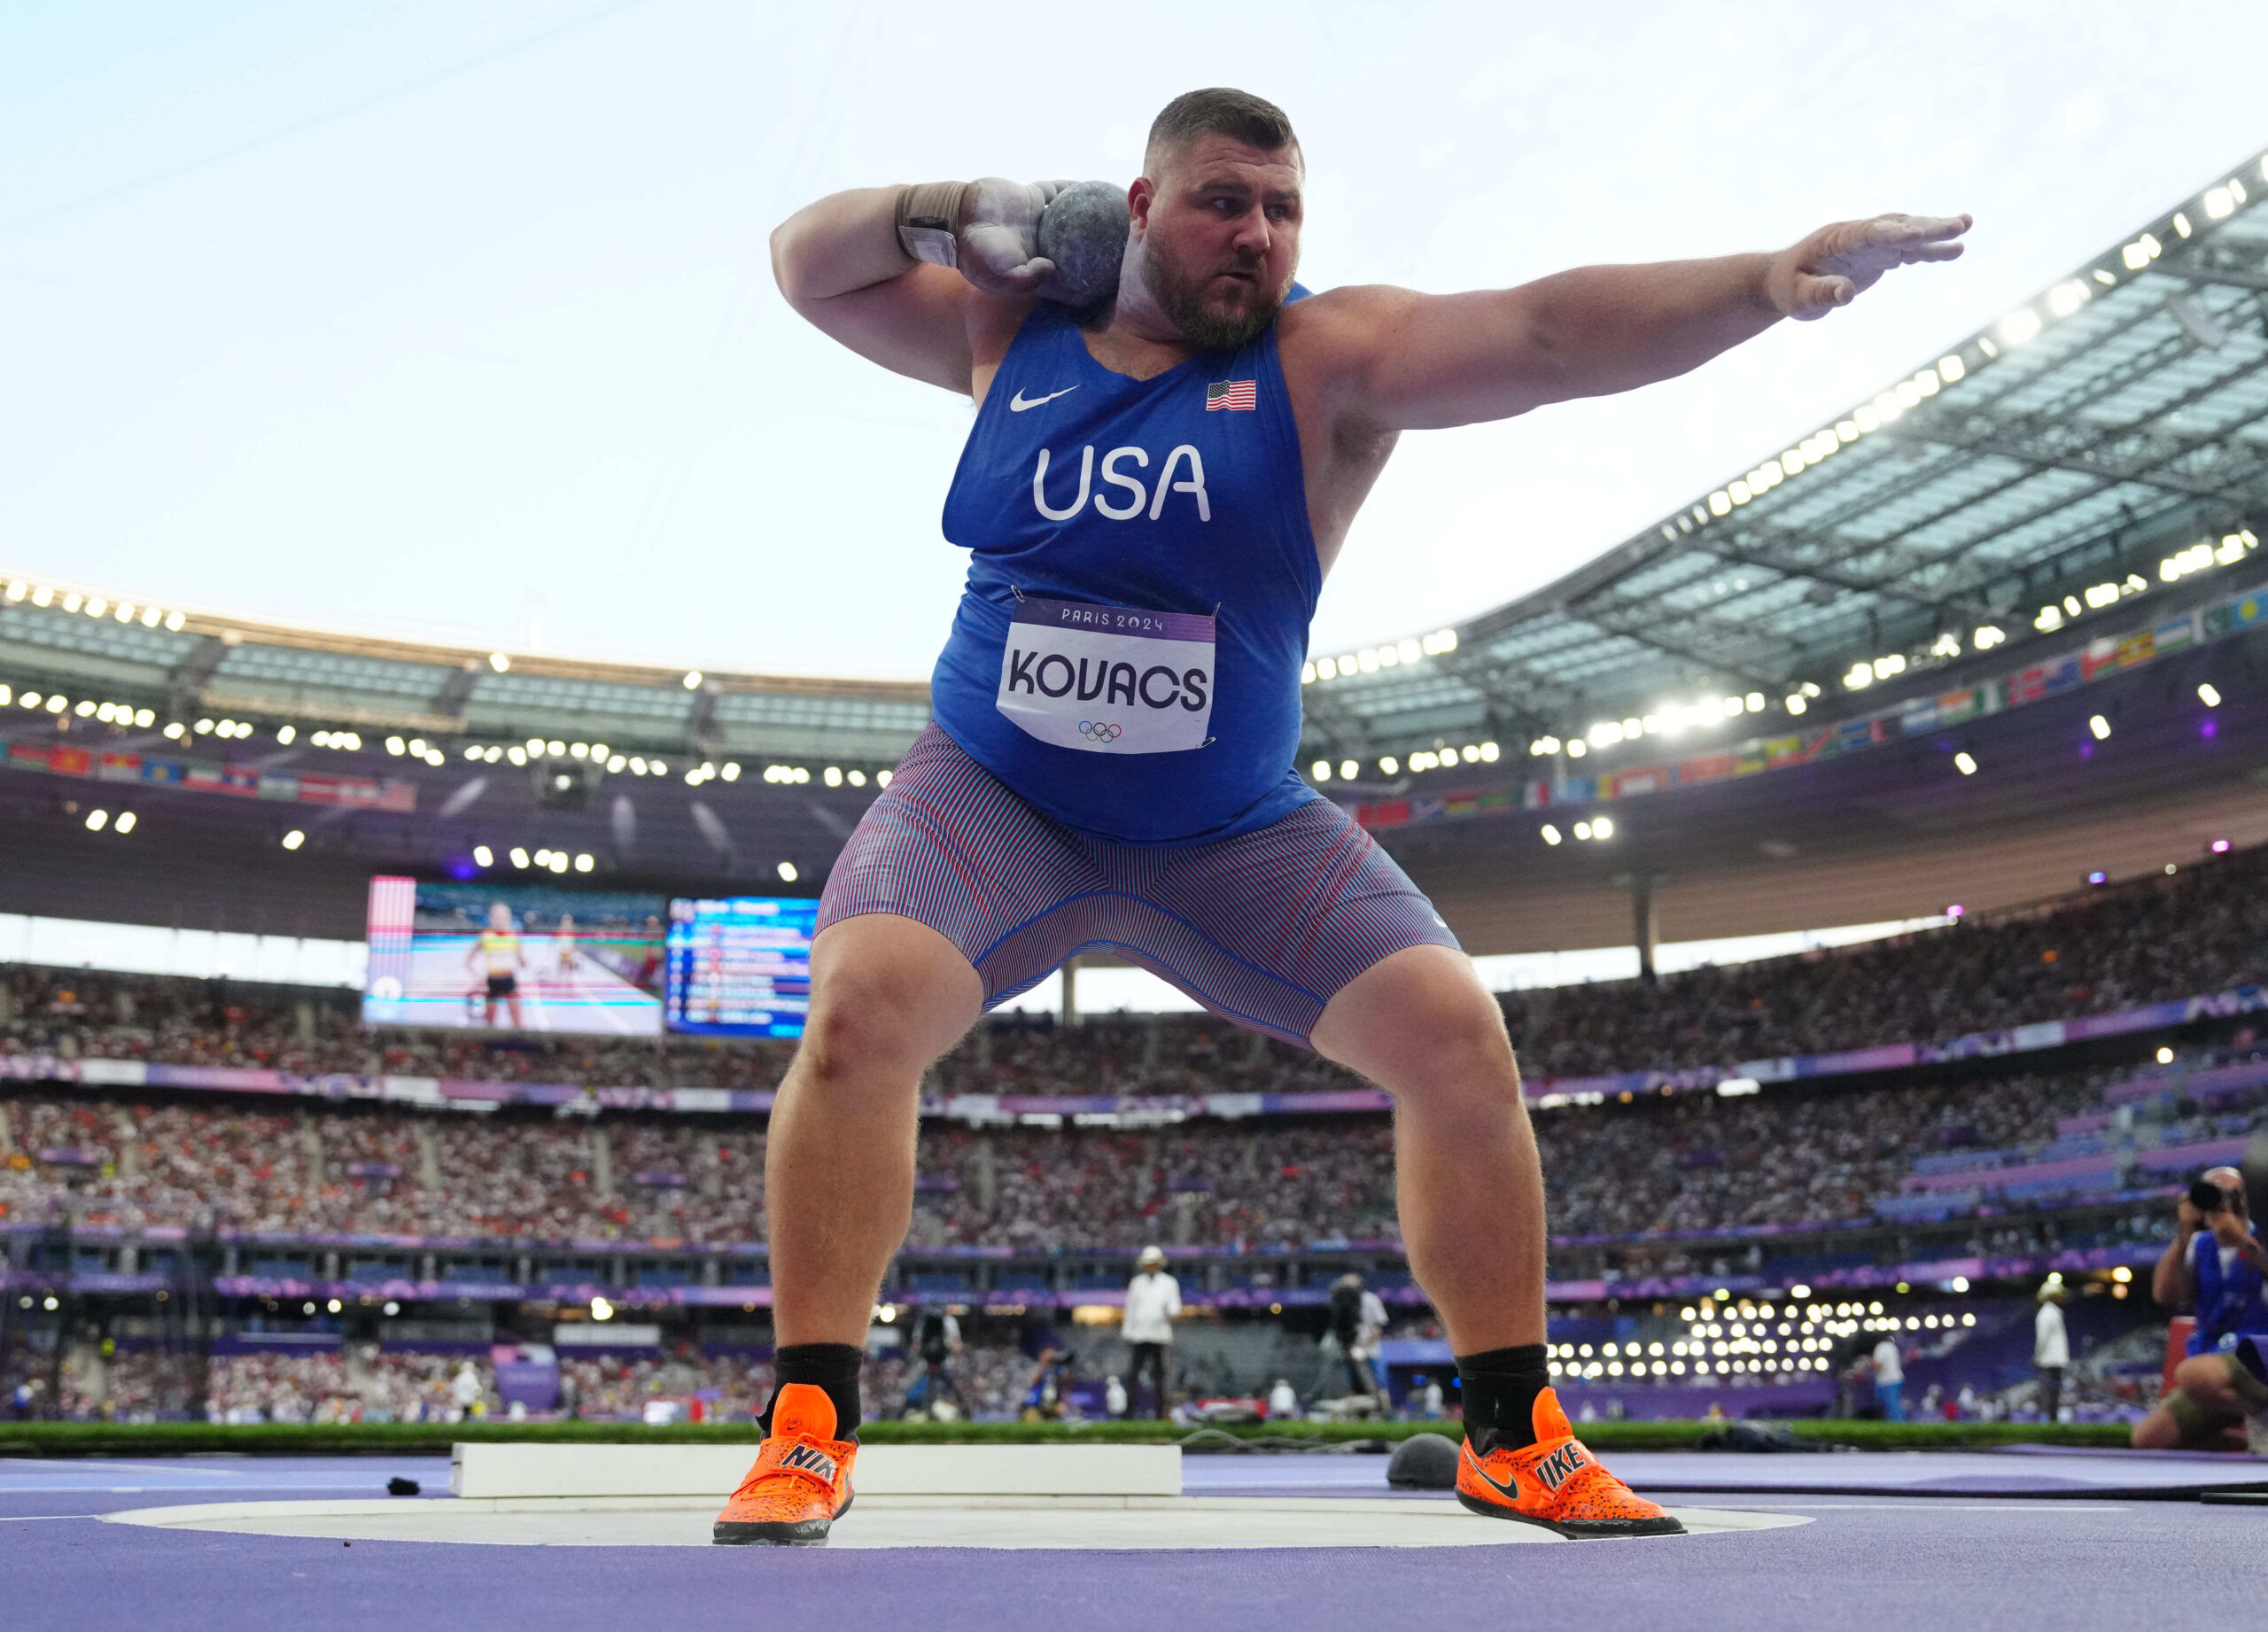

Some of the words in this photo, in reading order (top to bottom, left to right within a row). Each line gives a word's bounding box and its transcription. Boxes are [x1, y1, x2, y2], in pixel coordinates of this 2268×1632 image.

[1033, 445, 1211, 522] USA
[1116, 615, 1163, 631] 2024
[1008, 649, 1208, 711] KOVACS
[780, 1443, 837, 1482] NIK
